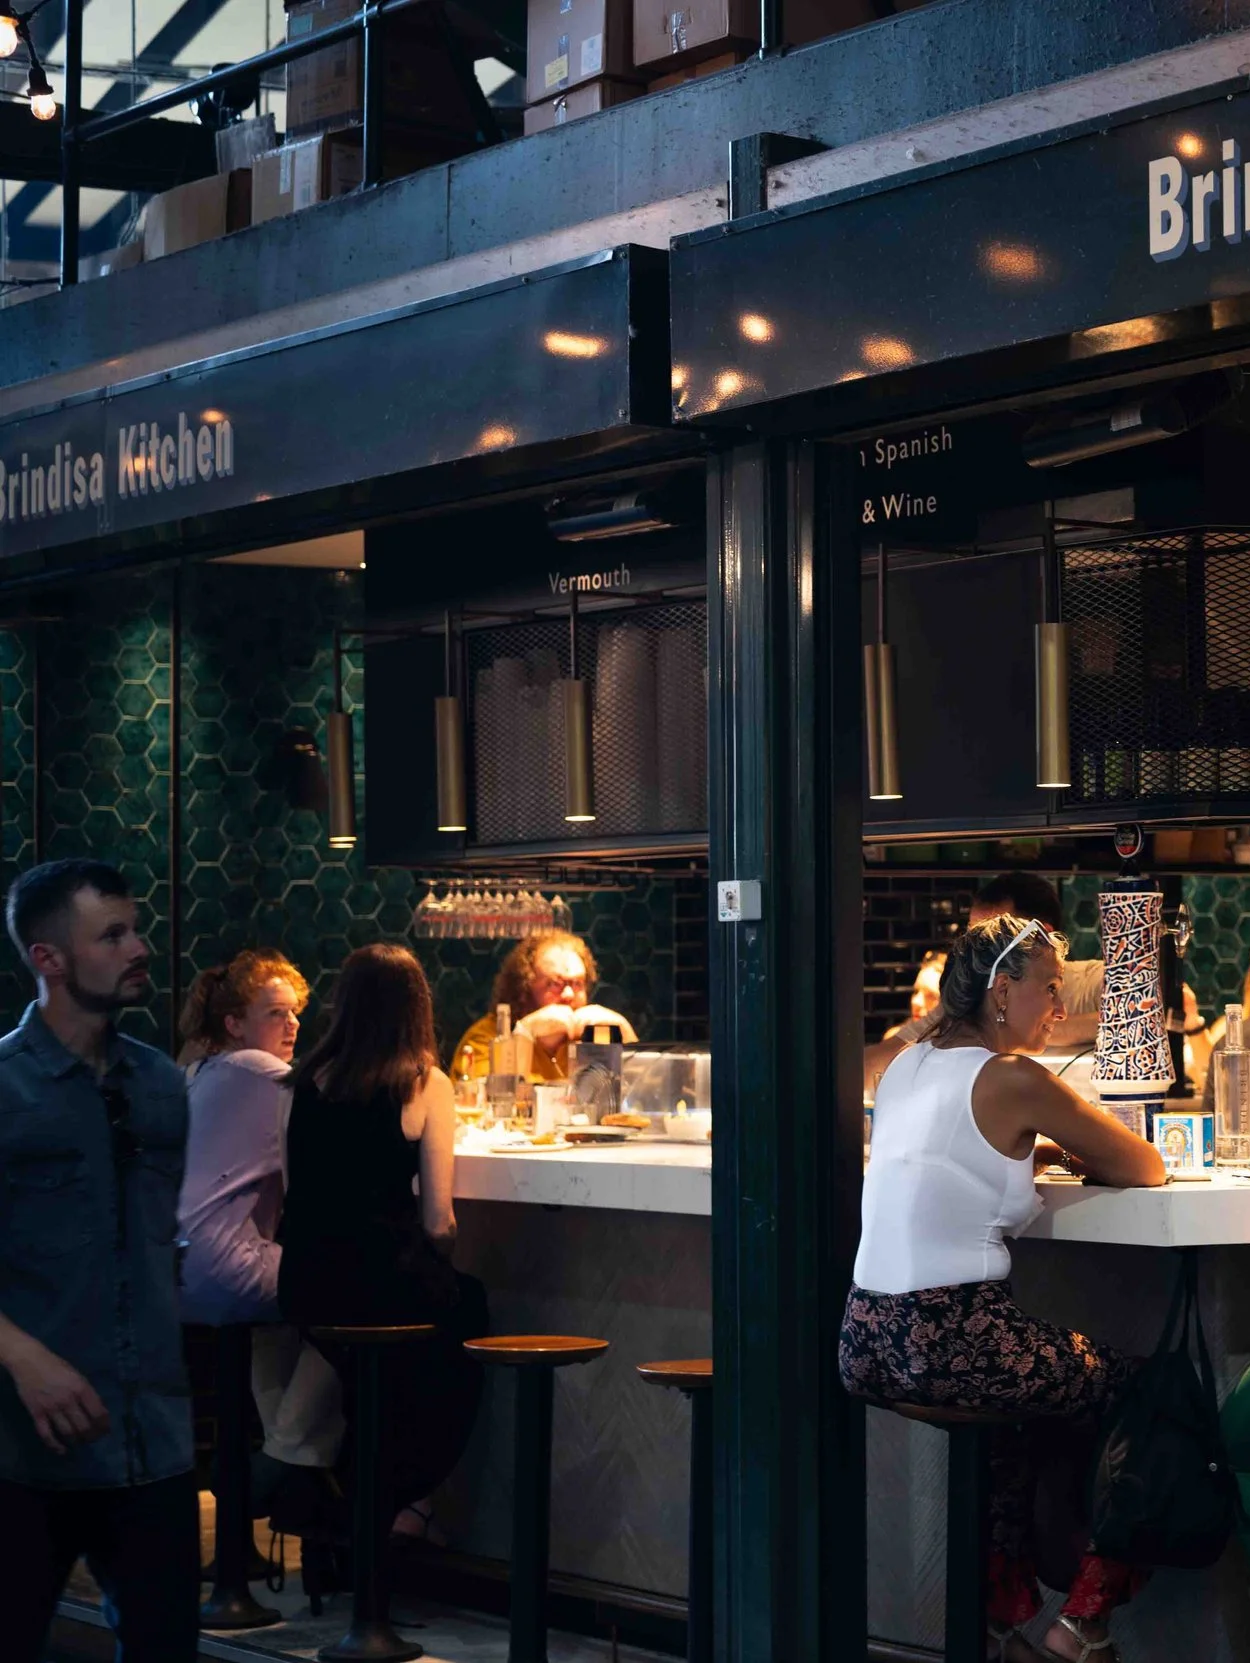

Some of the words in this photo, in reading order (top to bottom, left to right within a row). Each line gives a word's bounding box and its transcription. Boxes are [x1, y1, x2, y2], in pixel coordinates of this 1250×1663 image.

[118, 411, 234, 498] Kitchen
[875, 425, 953, 470] Spanish
[862, 499, 876, 524] &
[882, 493, 937, 520] Wine
[548, 562, 631, 595] Vermouth
